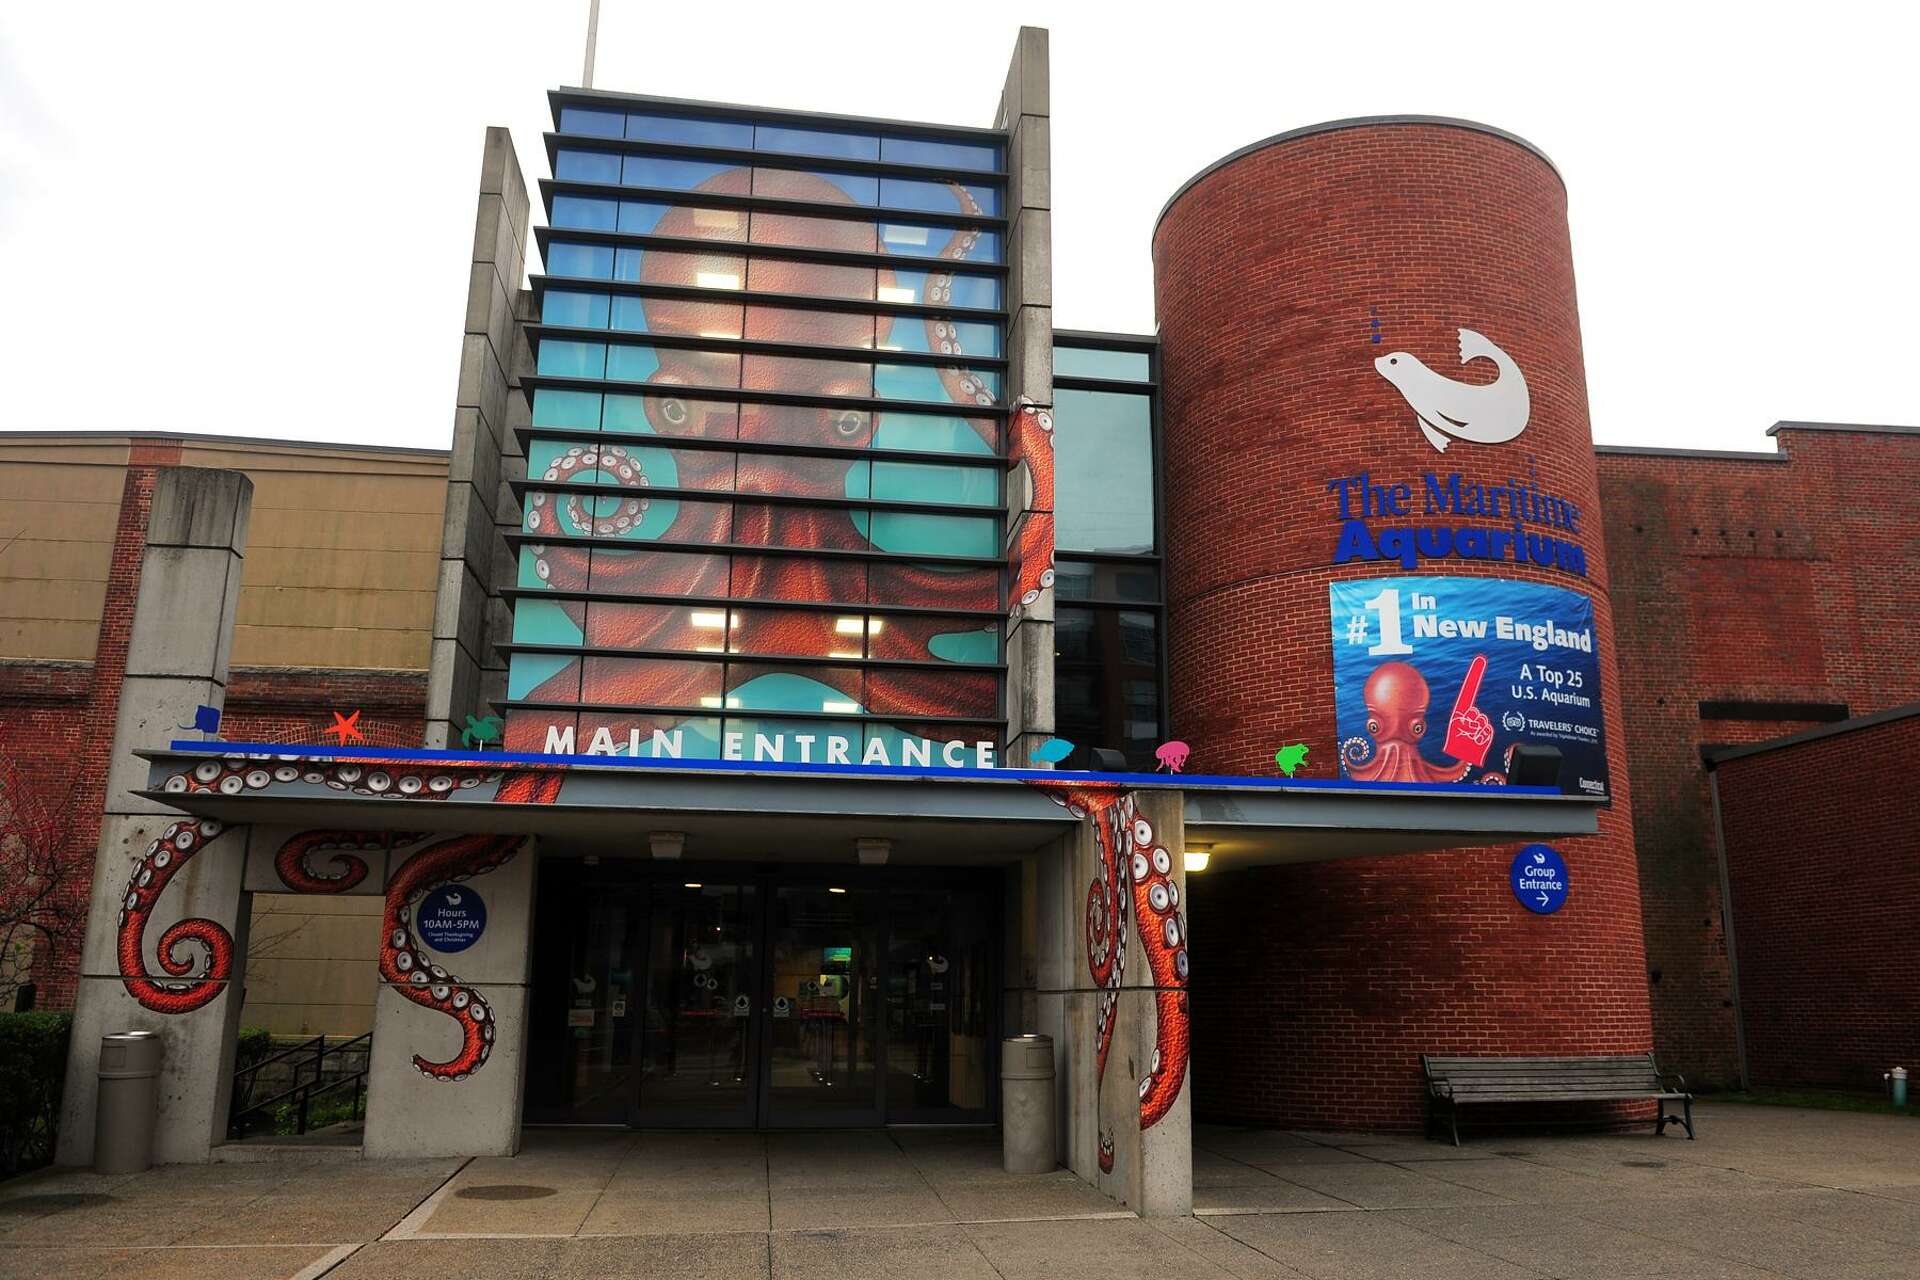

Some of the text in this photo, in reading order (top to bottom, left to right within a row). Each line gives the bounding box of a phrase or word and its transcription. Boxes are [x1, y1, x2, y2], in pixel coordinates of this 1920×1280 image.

[1328, 471, 1582, 534] The Maritime
[1333, 520, 1587, 577] Aquarium
[1412, 592, 1436, 610] In
[1347, 588, 1413, 656] #1
[1413, 614, 1592, 653] New England
[1520, 663, 1583, 689] A Top 25
[1511, 685, 1591, 708] U.S. Aquarium
[543, 725, 995, 769] MAIN ENTRANCE
[1519, 878, 1562, 890] Entrance
[1524, 865, 1556, 880] Group
[423, 919, 480, 929] 10AM-5PM
[437, 908, 467, 918] Hours
